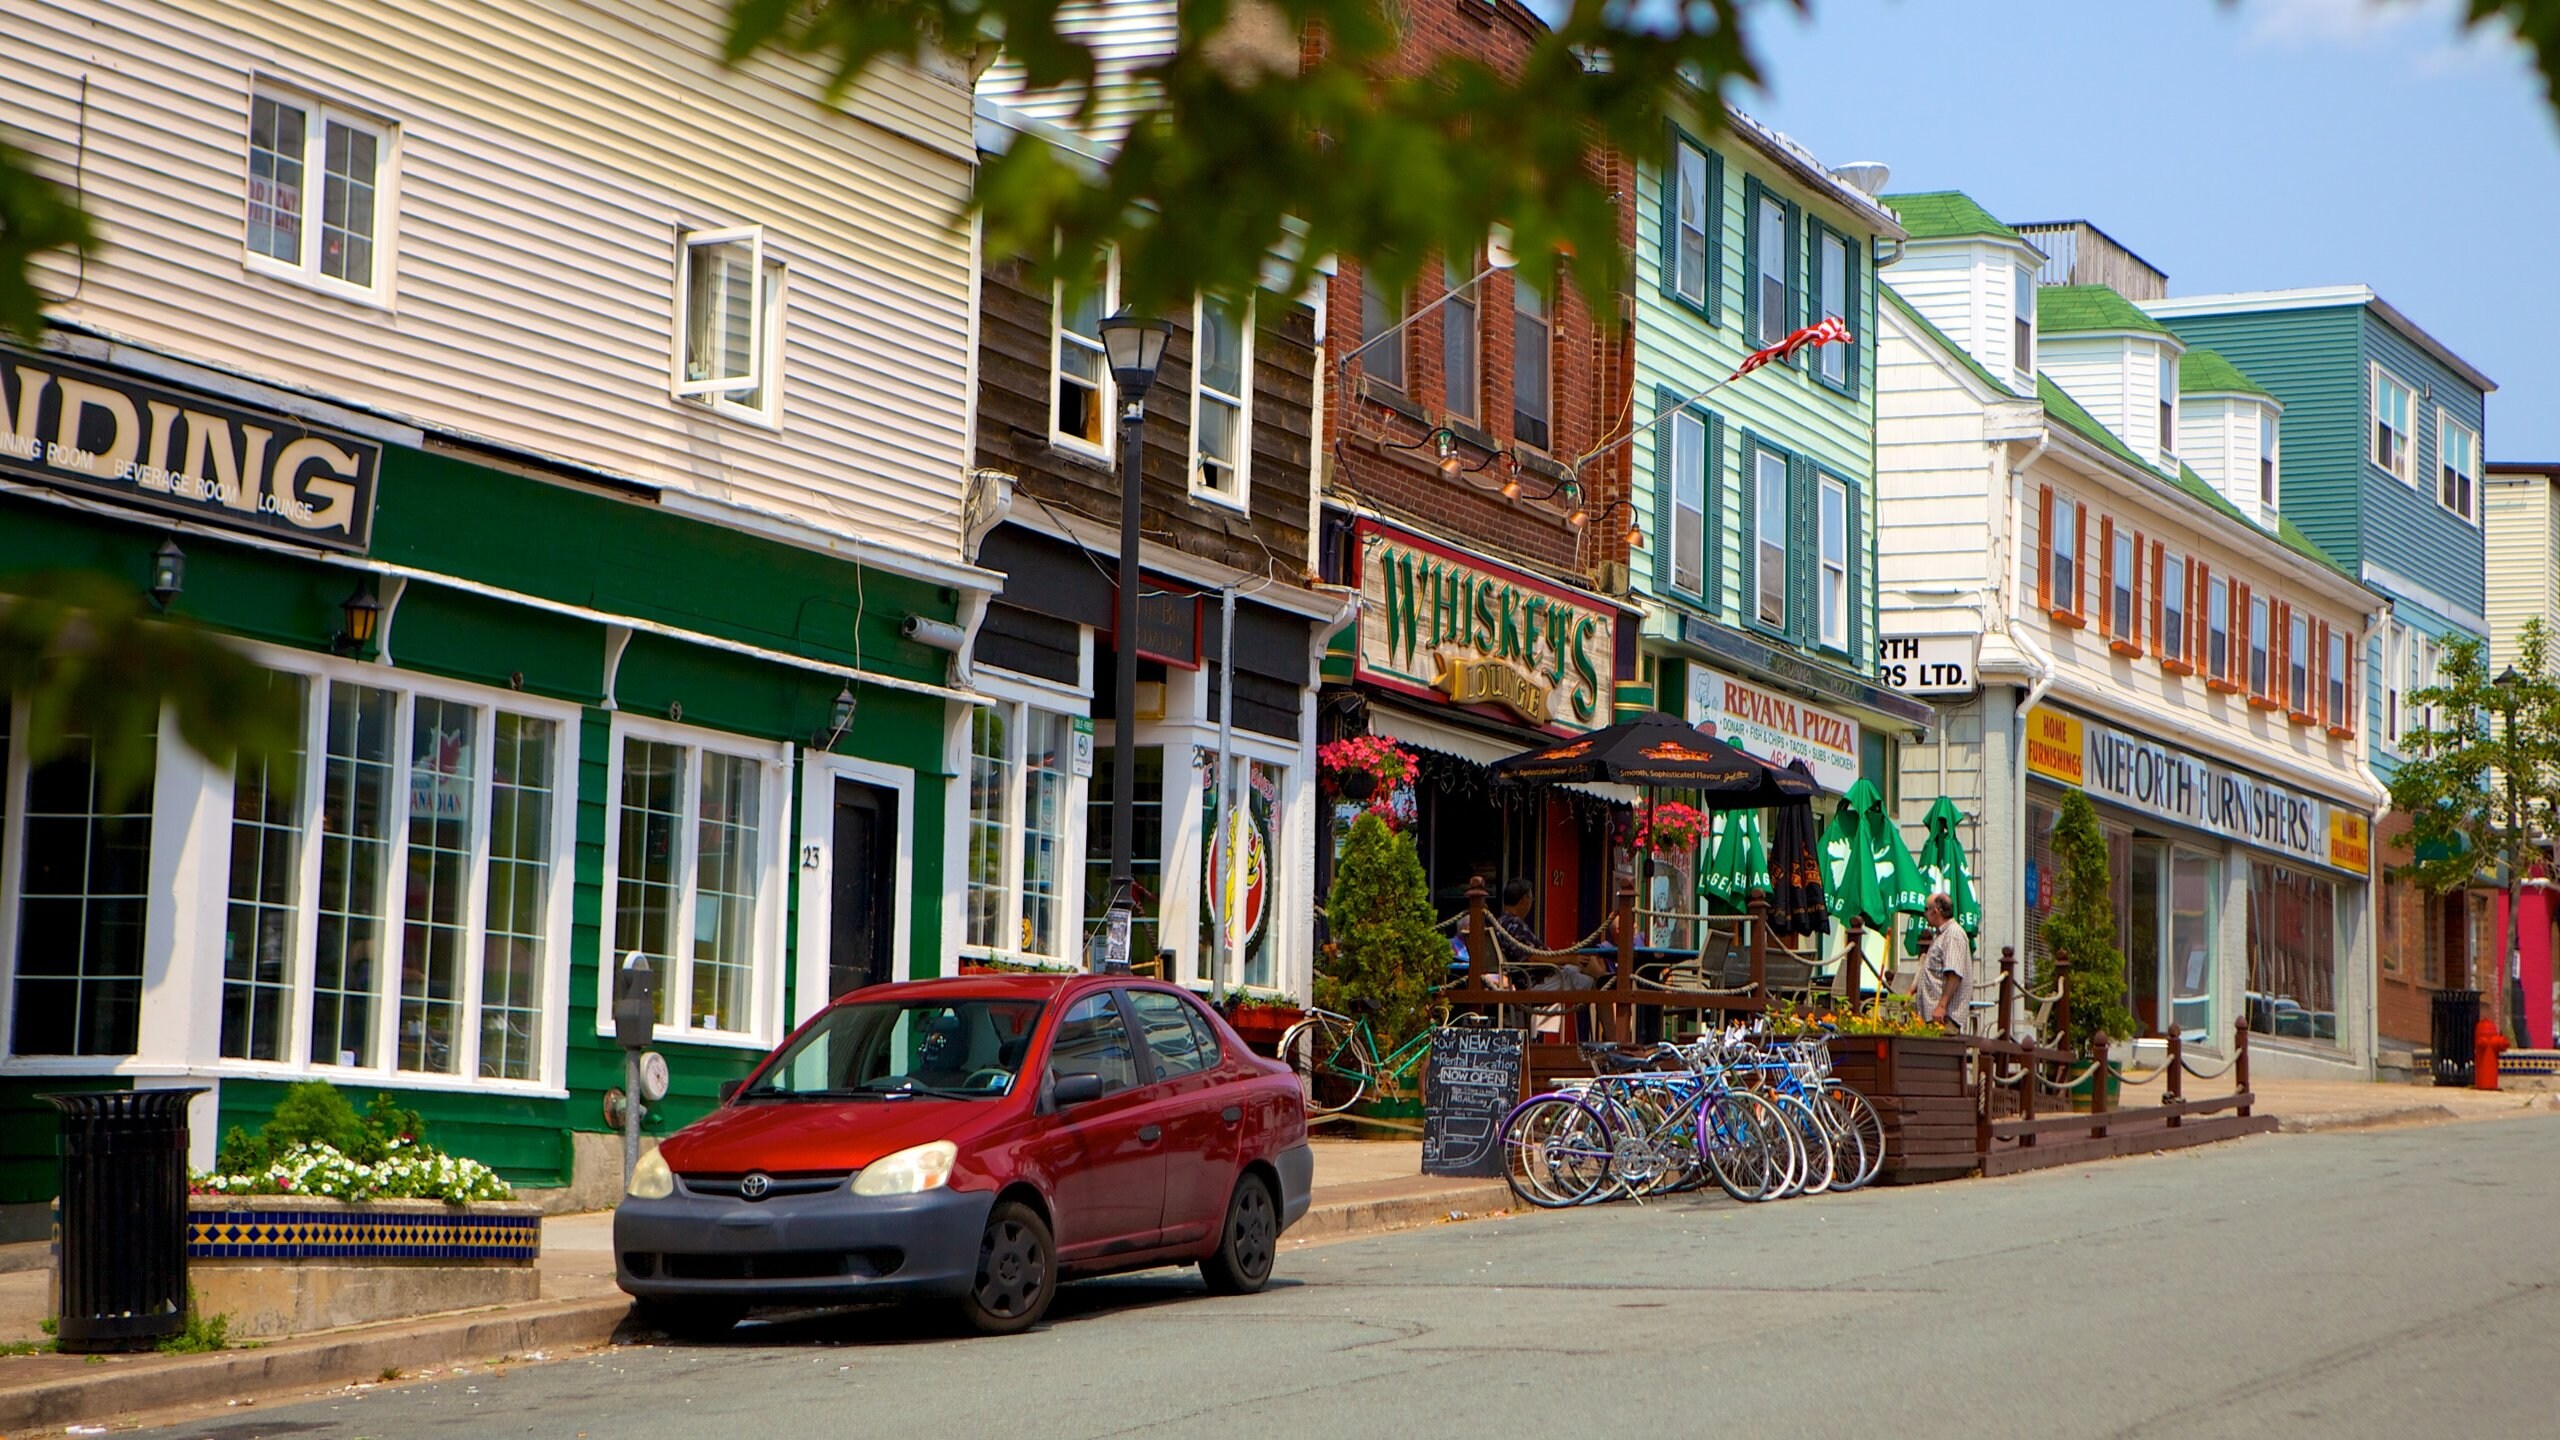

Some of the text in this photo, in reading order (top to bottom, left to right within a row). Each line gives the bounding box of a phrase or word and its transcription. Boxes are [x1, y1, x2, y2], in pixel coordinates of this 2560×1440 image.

[46, 441, 95, 471] ROOM
[114, 458, 189, 494] BEVERAGE
[195, 478, 237, 504] ROOM
[258, 492, 313, 522] LOUNGE
[1380, 542, 1598, 722] WHISKEY'S
[1879, 638, 1919, 659] RTH
[1879, 663, 1967, 687] RS LTD.
[1466, 664, 1541, 718] LOUNGE
[1724, 681, 1853, 755] REVANA PIZZA
[2043, 714, 2067, 744] HOME
[1722, 718, 1744, 735] DONAIR
[1749, 727, 1762, 740] FISH
[1769, 733, 1785, 749] CHIPS
[1789, 740, 1808, 756] TACOS
[1812, 747, 1827, 762] SUBS
[1830, 754, 1854, 771] CHICKEN
[2028, 738, 2082, 778] FURNISHINGS
[1650, 770, 1695, 780] Sophisticated
[1696, 771, 1721, 780] Flavour
[2090, 730, 2192, 816] NIEFORTH
[2199, 767, 2309, 852] FURNISHERS
[802, 845, 820, 870] 23
[1553, 869, 1565, 887] 27
[1438, 1036, 1456, 1050] Our
[1459, 1033, 1491, 1052] NEW
[1439, 1050, 1518, 1072] Rental Location
[1443, 1070, 1468, 1081] NOW
